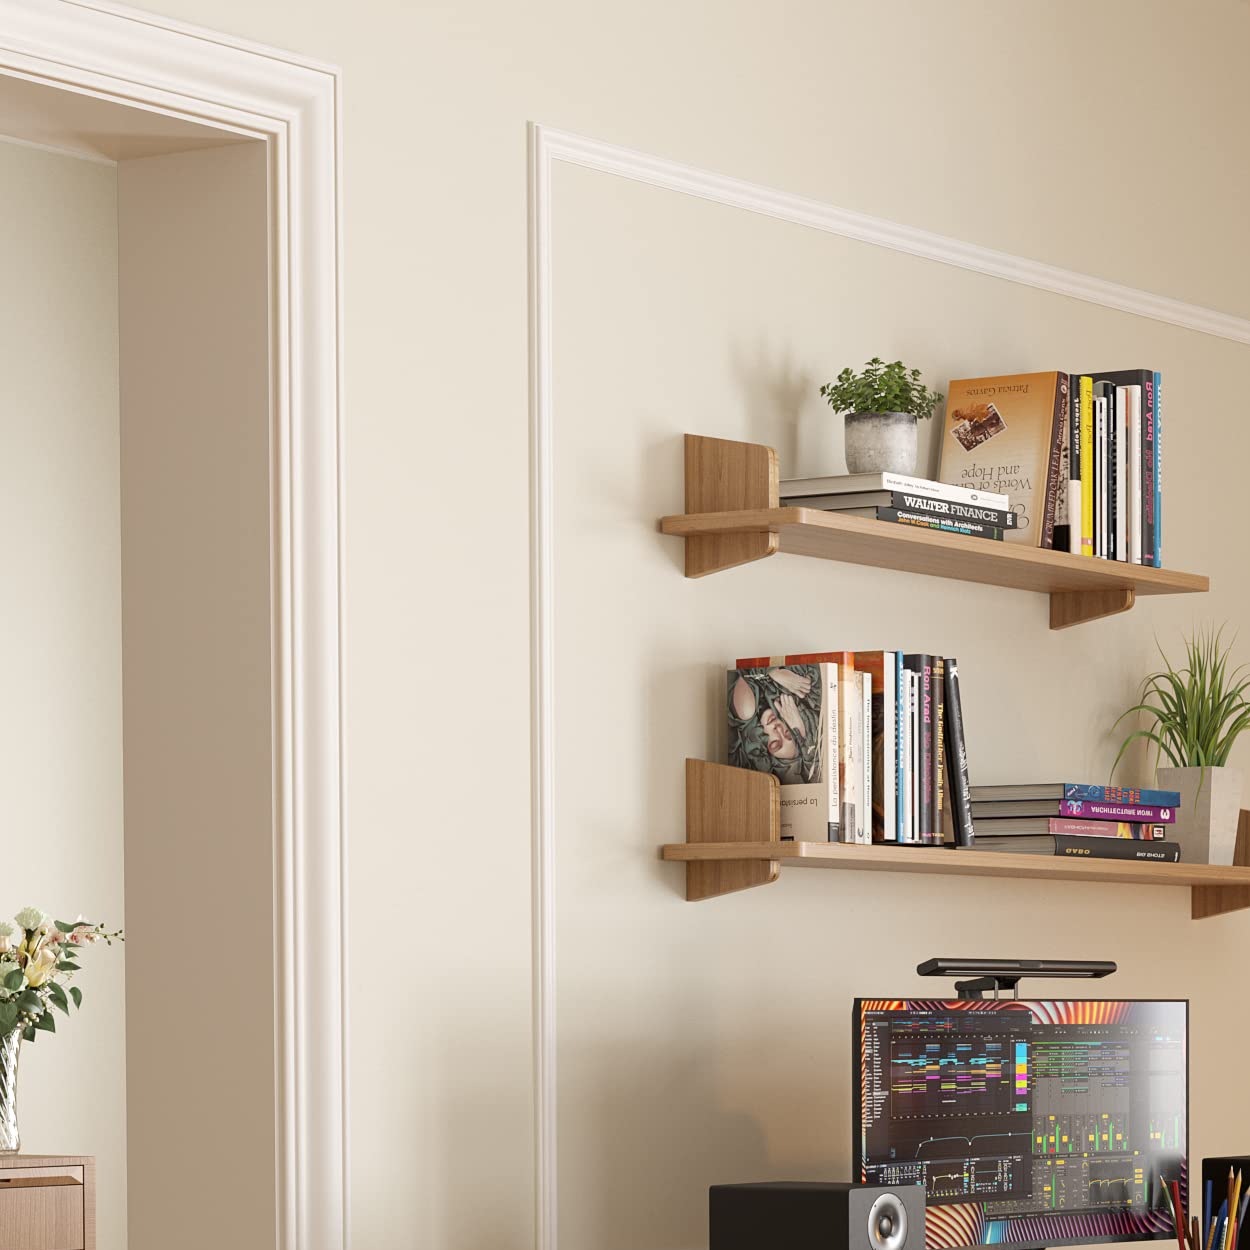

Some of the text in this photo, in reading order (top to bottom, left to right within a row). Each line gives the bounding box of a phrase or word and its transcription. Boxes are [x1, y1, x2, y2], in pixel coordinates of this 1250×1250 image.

[966, 384, 1030, 397] Patricia Gavros
[961, 464, 1020, 480] and Hope
[993, 477, 1032, 492] Words
[903, 496, 950, 514] WALTER
[950, 504, 998, 523] FINANCE
[897, 511, 983, 532] Conversations with Architects
[810, 798, 817, 807] La
